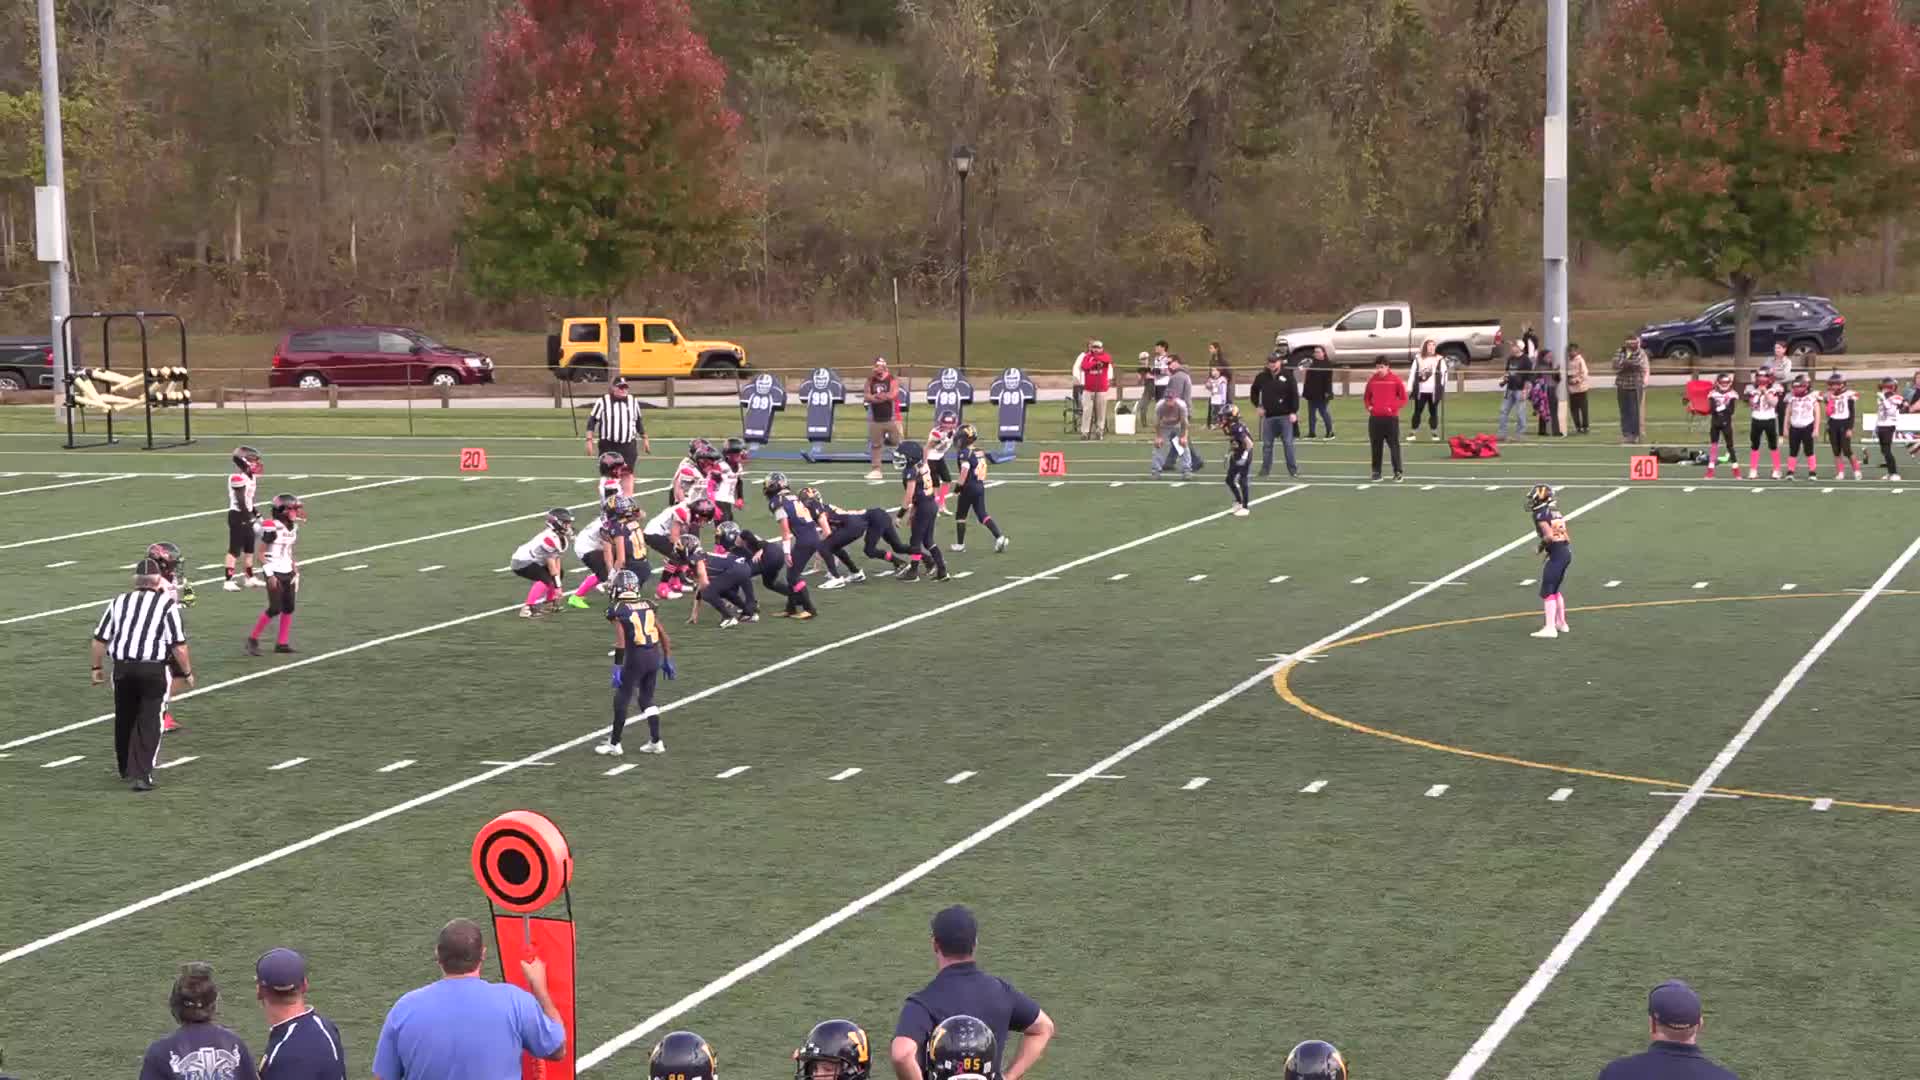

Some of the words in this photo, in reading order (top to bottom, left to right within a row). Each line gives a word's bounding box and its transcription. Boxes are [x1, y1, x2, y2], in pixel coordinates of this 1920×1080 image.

[463, 451, 480, 468] 20
[1042, 455, 1059, 472] 30
[1634, 459, 1653, 477] 40
[629, 609, 659, 645] 14
[963, 1057, 981, 1071] 85
